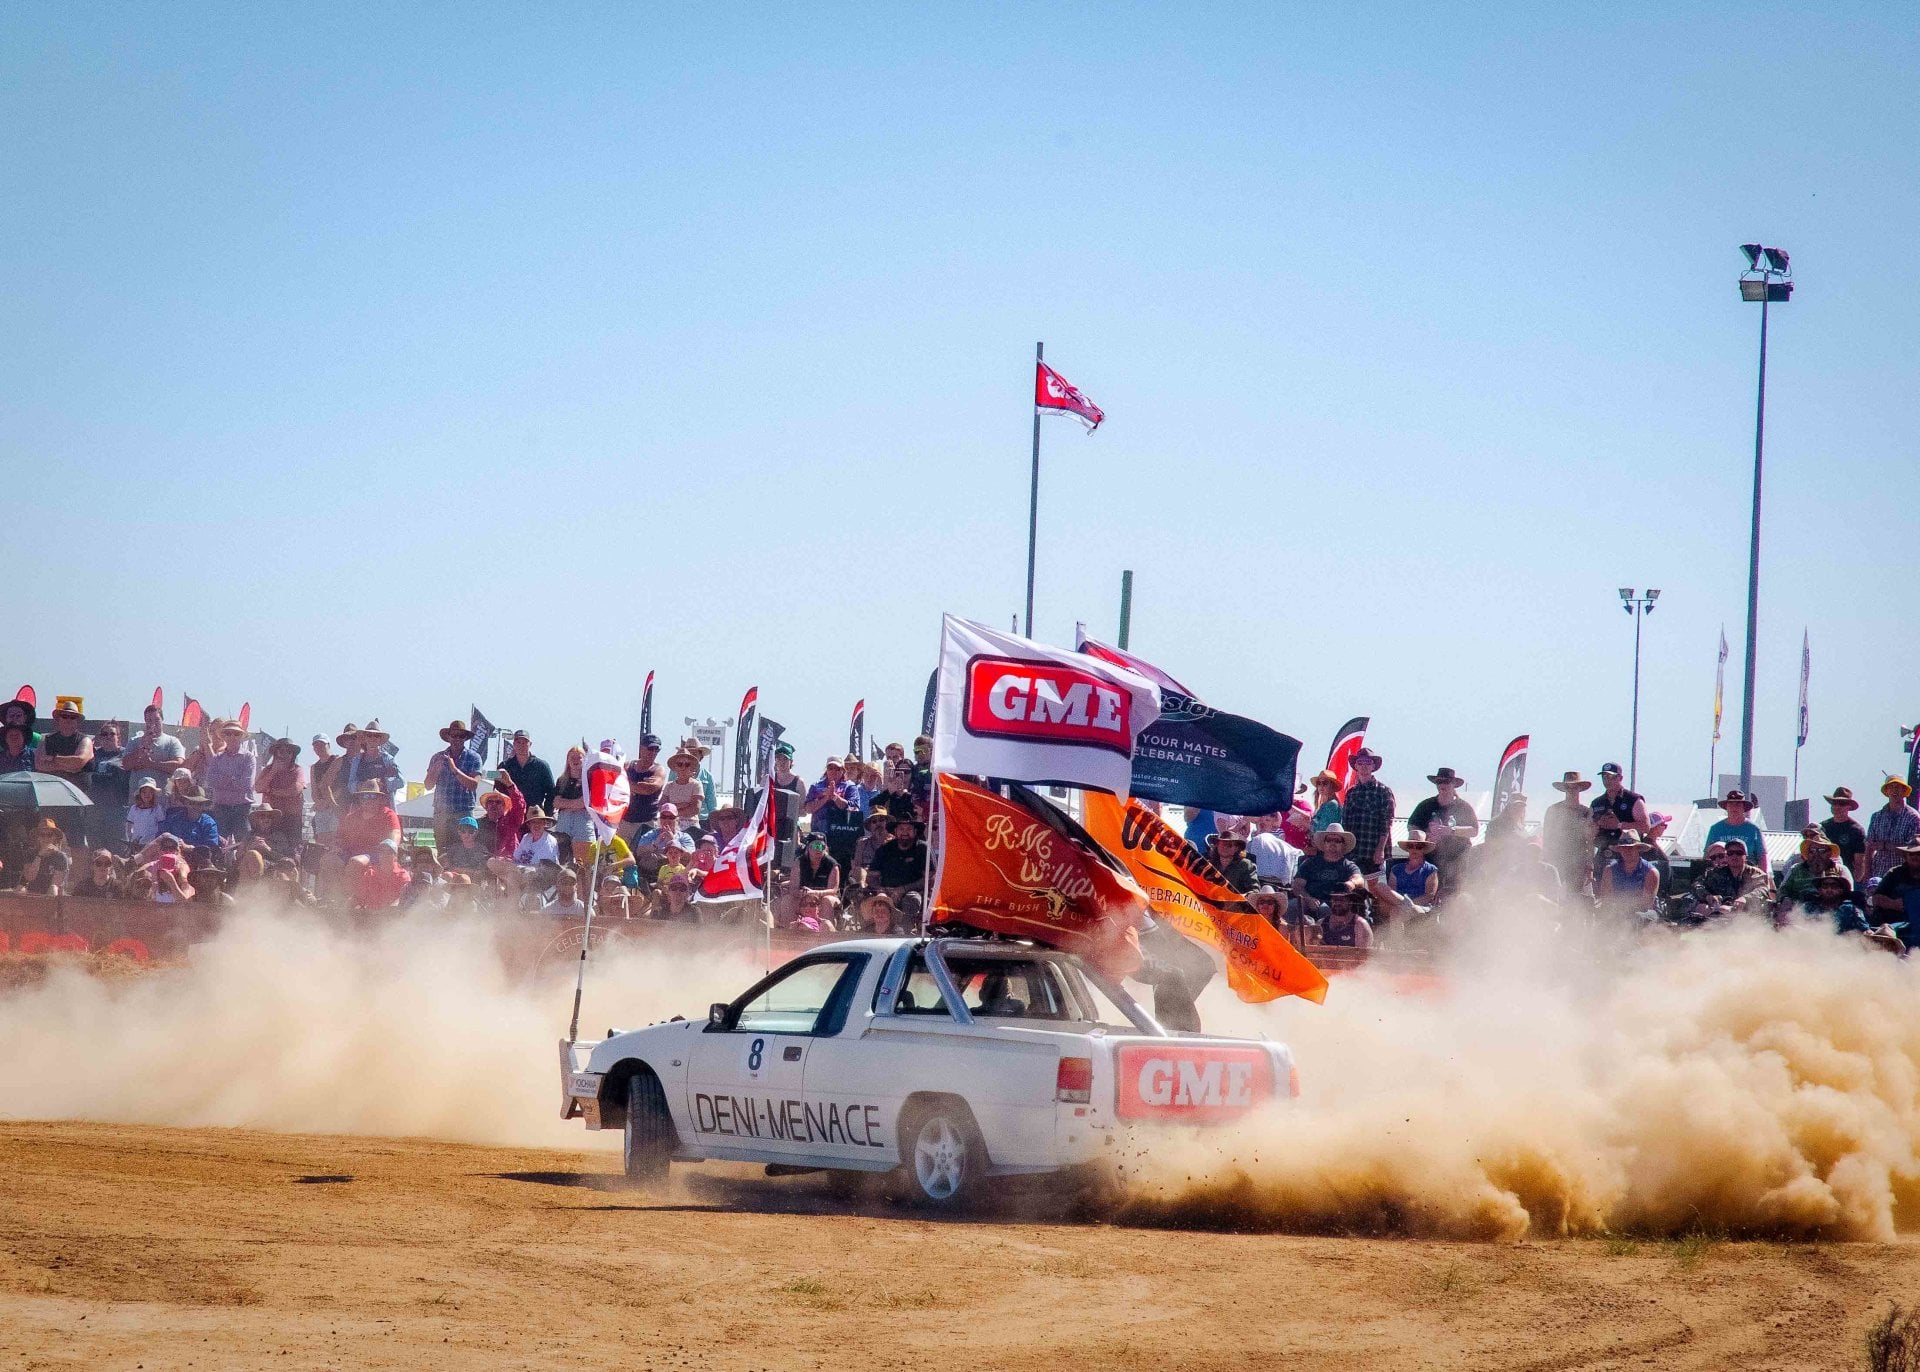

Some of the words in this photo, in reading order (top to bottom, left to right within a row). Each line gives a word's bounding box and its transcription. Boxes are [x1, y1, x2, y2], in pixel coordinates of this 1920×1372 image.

[988, 674, 1121, 732] GME
[1143, 733, 1179, 748] YOUR
[1183, 741, 1227, 758] MATES
[976, 895, 1000, 906] THE
[1008, 902, 1040, 911] BUSH
[748, 1038, 765, 1071] 8
[1138, 1058, 1252, 1106] GME
[695, 1093, 885, 1148] DENI-MENACE
